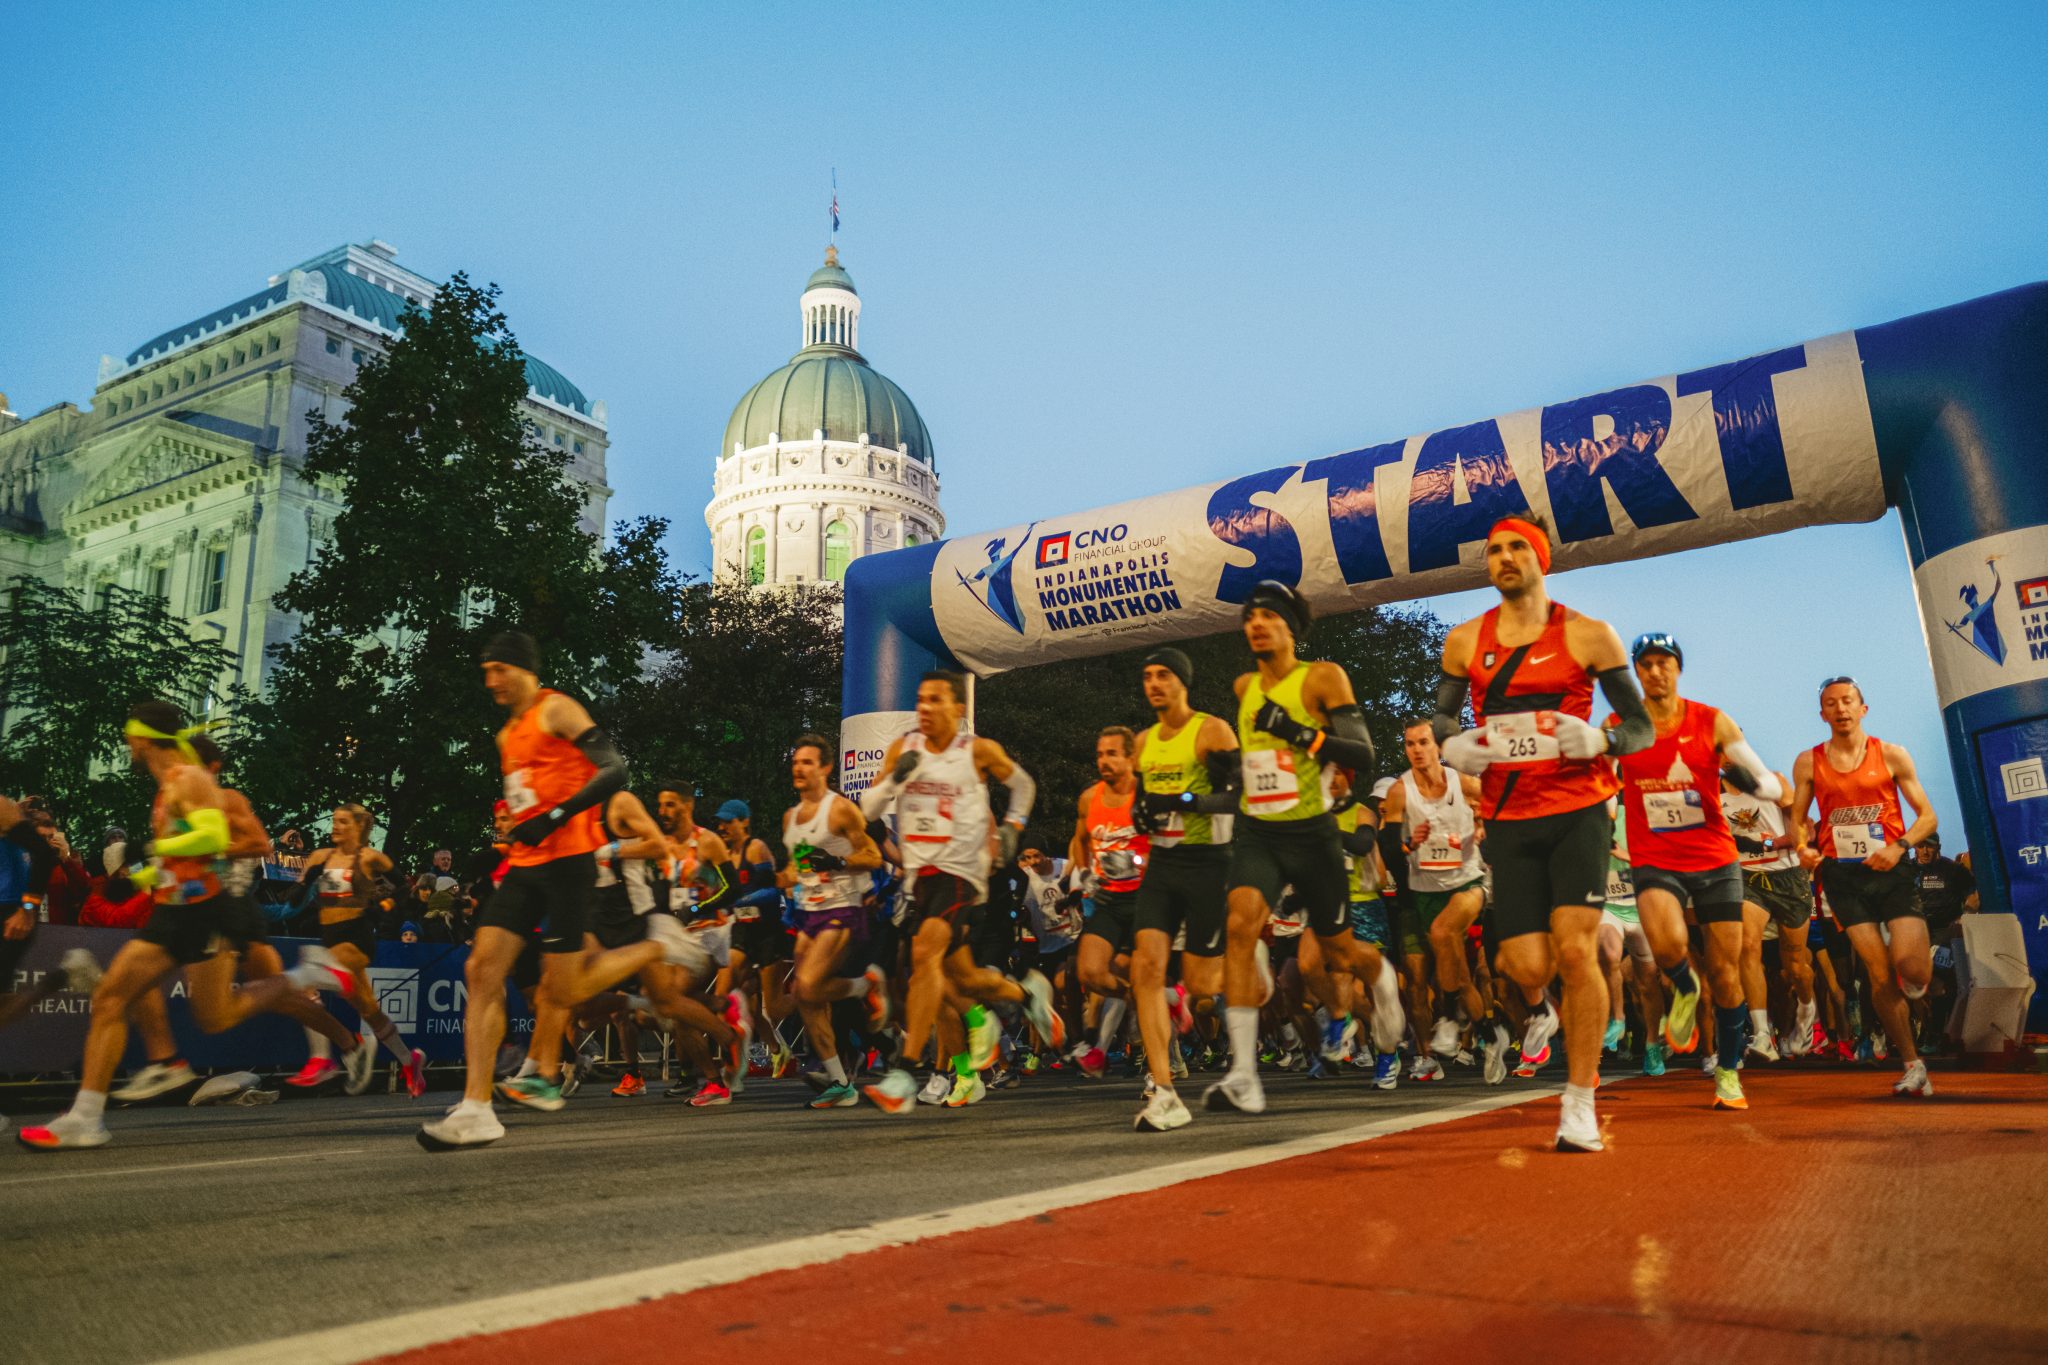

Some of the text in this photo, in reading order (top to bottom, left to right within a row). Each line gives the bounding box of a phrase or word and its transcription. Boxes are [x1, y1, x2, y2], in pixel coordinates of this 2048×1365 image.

[1206, 344, 1807, 605] START
[1075, 523, 1128, 549] CNO
[1074, 535, 1167, 563] FINANCIAL GROUP
[1035, 552, 1169, 589] INDIANAPOLIS
[1039, 568, 1174, 609] MONUMENTAL
[1045, 589, 1182, 631] MARATHON
[857, 749, 884, 762] CNO
[1508, 737, 1537, 757] 263
[1257, 773, 1279, 791] 222
[1667, 810, 1683, 824] 51
[1431, 848, 1449, 860] 277
[1852, 841, 1867, 855] 73
[1606, 883, 1628, 895] 1858
